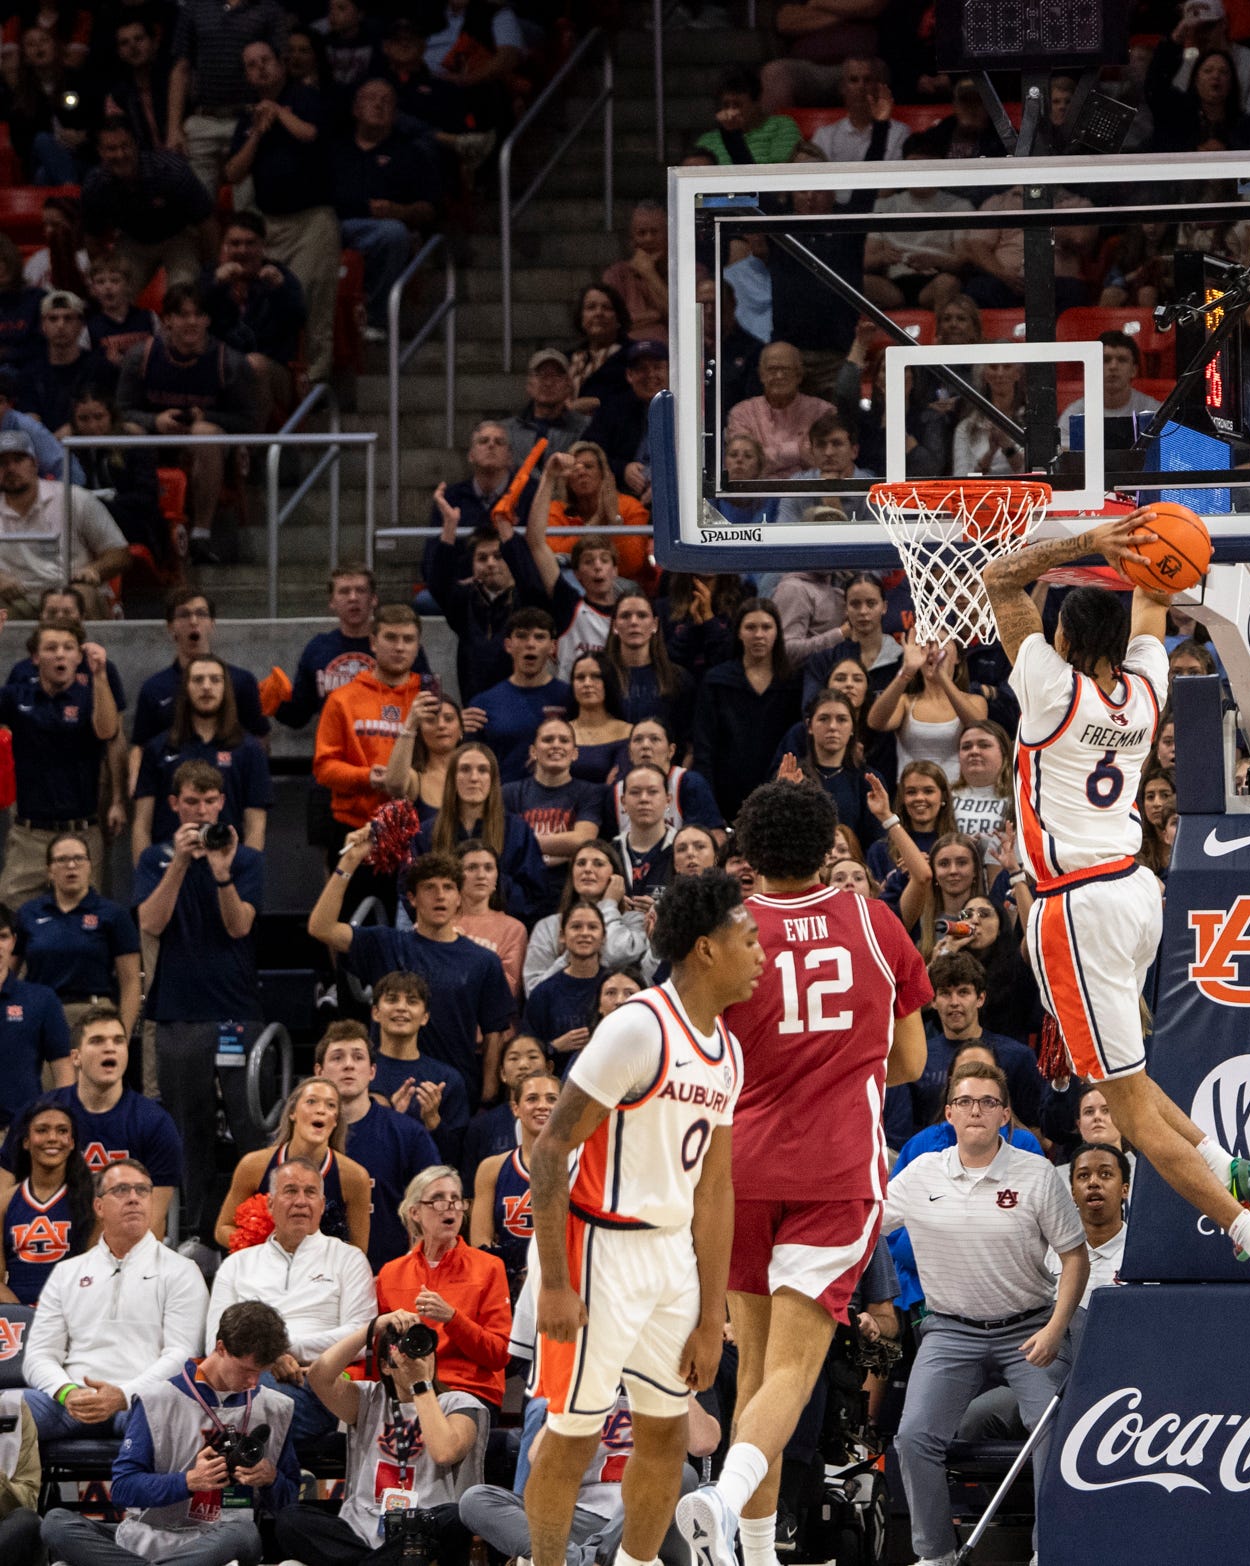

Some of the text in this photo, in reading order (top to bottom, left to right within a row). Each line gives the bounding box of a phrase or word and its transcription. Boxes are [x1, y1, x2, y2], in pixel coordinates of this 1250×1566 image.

[701, 529, 761, 543] SPALDING
[1080, 724, 1148, 748] FREEMAN
[1086, 750, 1124, 808] 6
[783, 915, 829, 943] EWIN
[774, 945, 853, 1034] 12
[681, 1118, 710, 1172] 0
